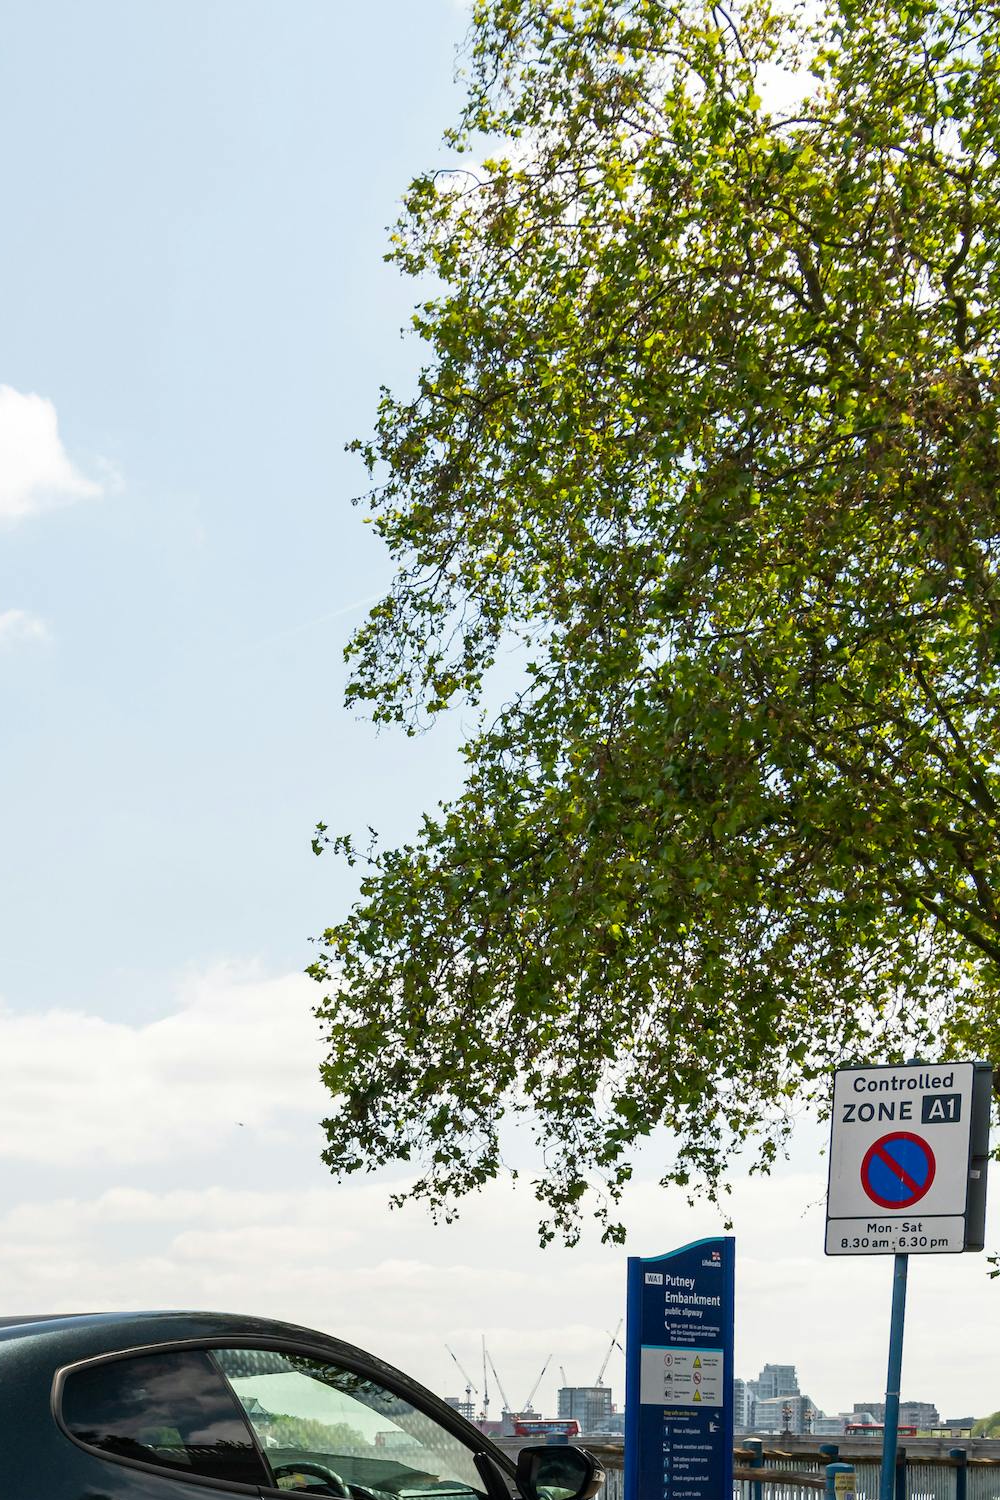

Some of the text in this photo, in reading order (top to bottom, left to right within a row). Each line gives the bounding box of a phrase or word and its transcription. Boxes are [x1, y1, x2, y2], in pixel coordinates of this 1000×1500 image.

[853, 1072, 954, 1093] Controlled
[842, 1098, 956, 1123] ZONE A1
[867, 1223, 892, 1233] Mon
[901, 1222, 923, 1233] Sat
[841, 1238, 869, 1249] 8.30
[872, 1240, 889, 1248] am
[898, 1236, 927, 1247] 6.30
[930, 1238, 949, 1248] pm
[665, 1274, 695, 1290] Putney
[665, 1291, 721, 1306] Embankment
[664, 1306, 703, 1319] public slipway
